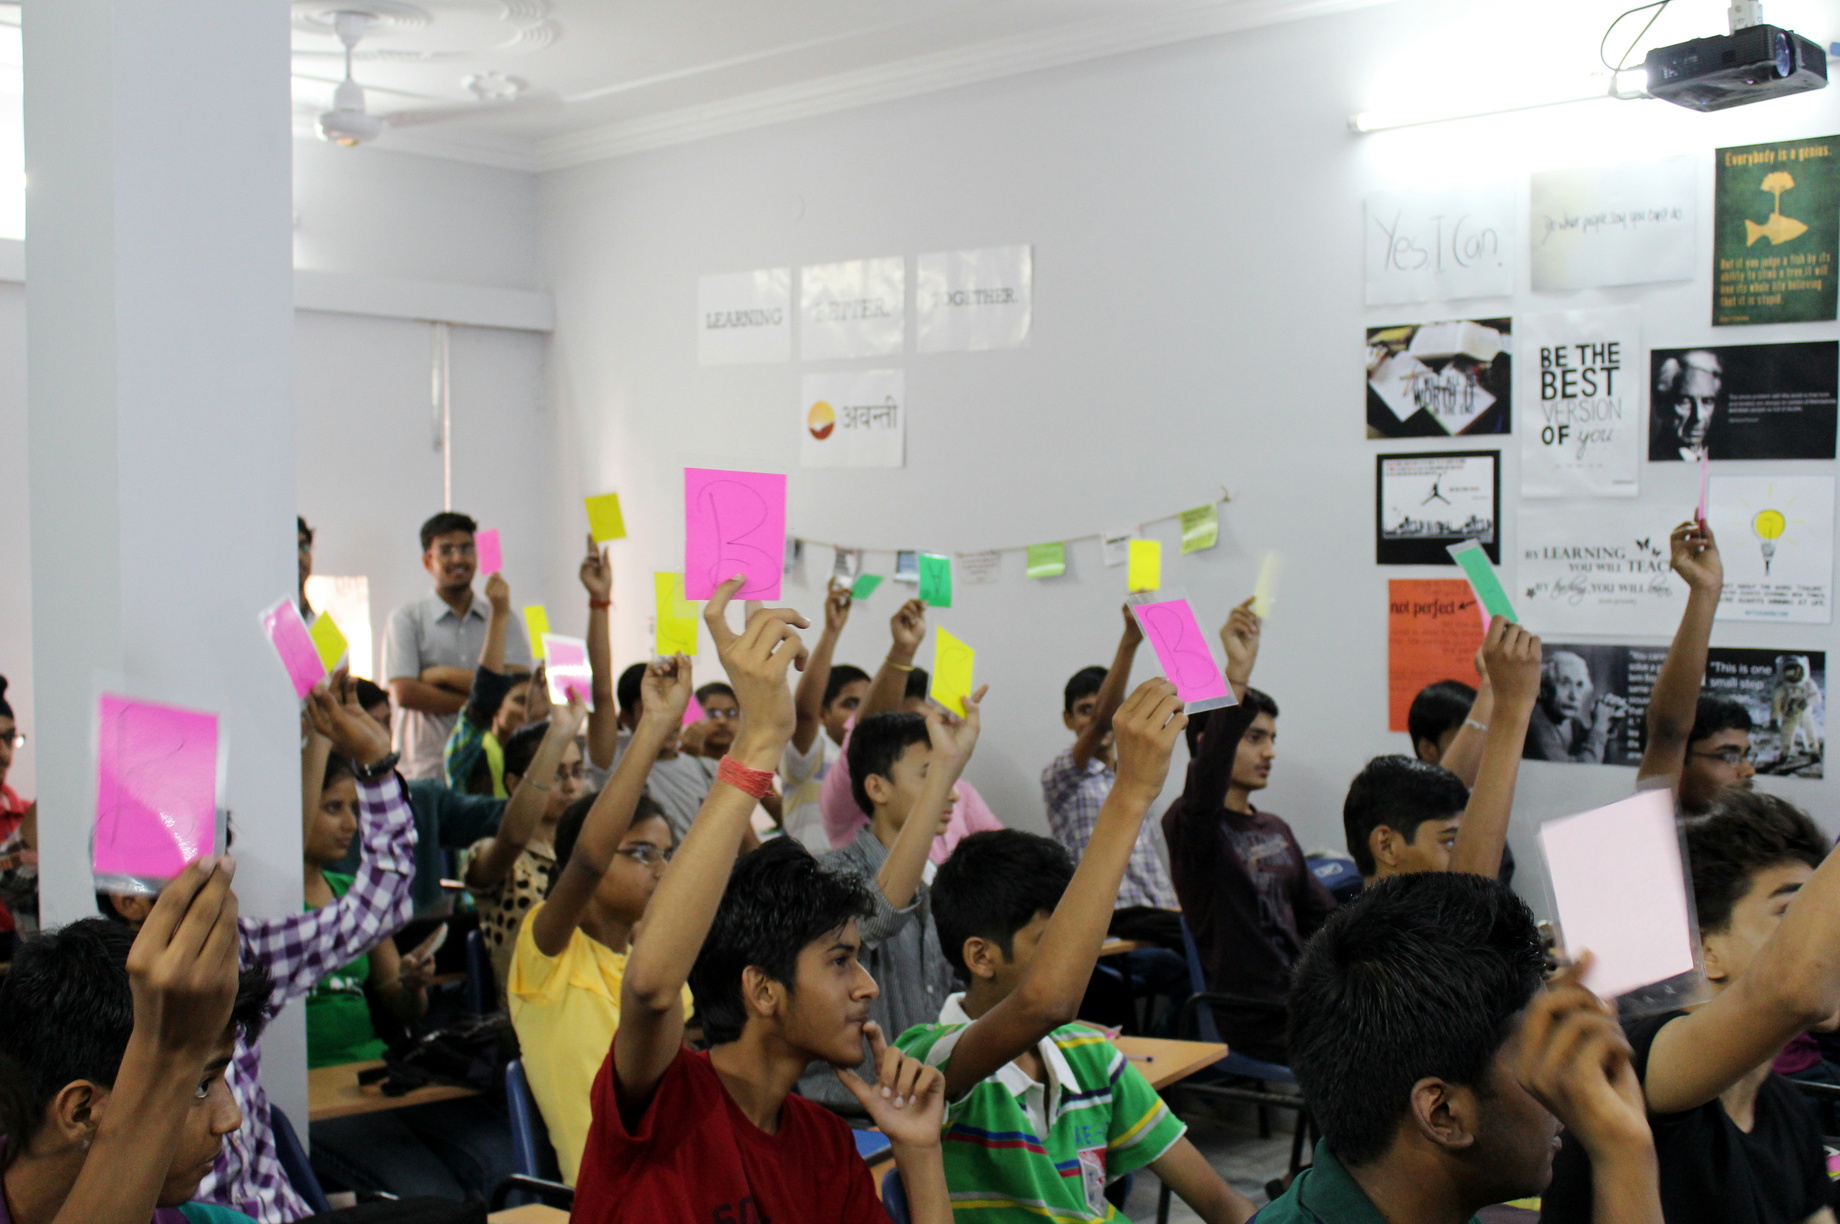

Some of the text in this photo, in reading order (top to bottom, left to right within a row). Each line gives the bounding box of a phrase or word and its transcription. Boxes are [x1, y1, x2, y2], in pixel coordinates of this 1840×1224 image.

[1725, 149, 1775, 167] Everybody
[1778, 149, 1787, 161] is
[1790, 149, 1796, 160] a
[1430, 214, 1447, 276] I
[1790, 253, 1805, 265] fish
[706, 306, 783, 330] LEARNING
[1540, 342, 1620, 369] BE THE
[1541, 366, 1620, 401] BEST
[1413, 386, 1457, 406] WORTH
[1541, 398, 1622, 423] VERSION
[1541, 425, 1613, 461] OF you
[698, 479, 781, 596] B
[1543, 546, 1626, 560] LEARNING
[1569, 563, 1593, 573] YOU
[1596, 563, 1621, 573] WILL
[1591, 583, 1615, 593] YOU
[1619, 583, 1644, 593] WILL
[1414, 598, 1455, 619] perfect
[1146, 605, 1217, 690] B
[1710, 660, 1772, 676] "This is one
[1709, 676, 1764, 691] small step
